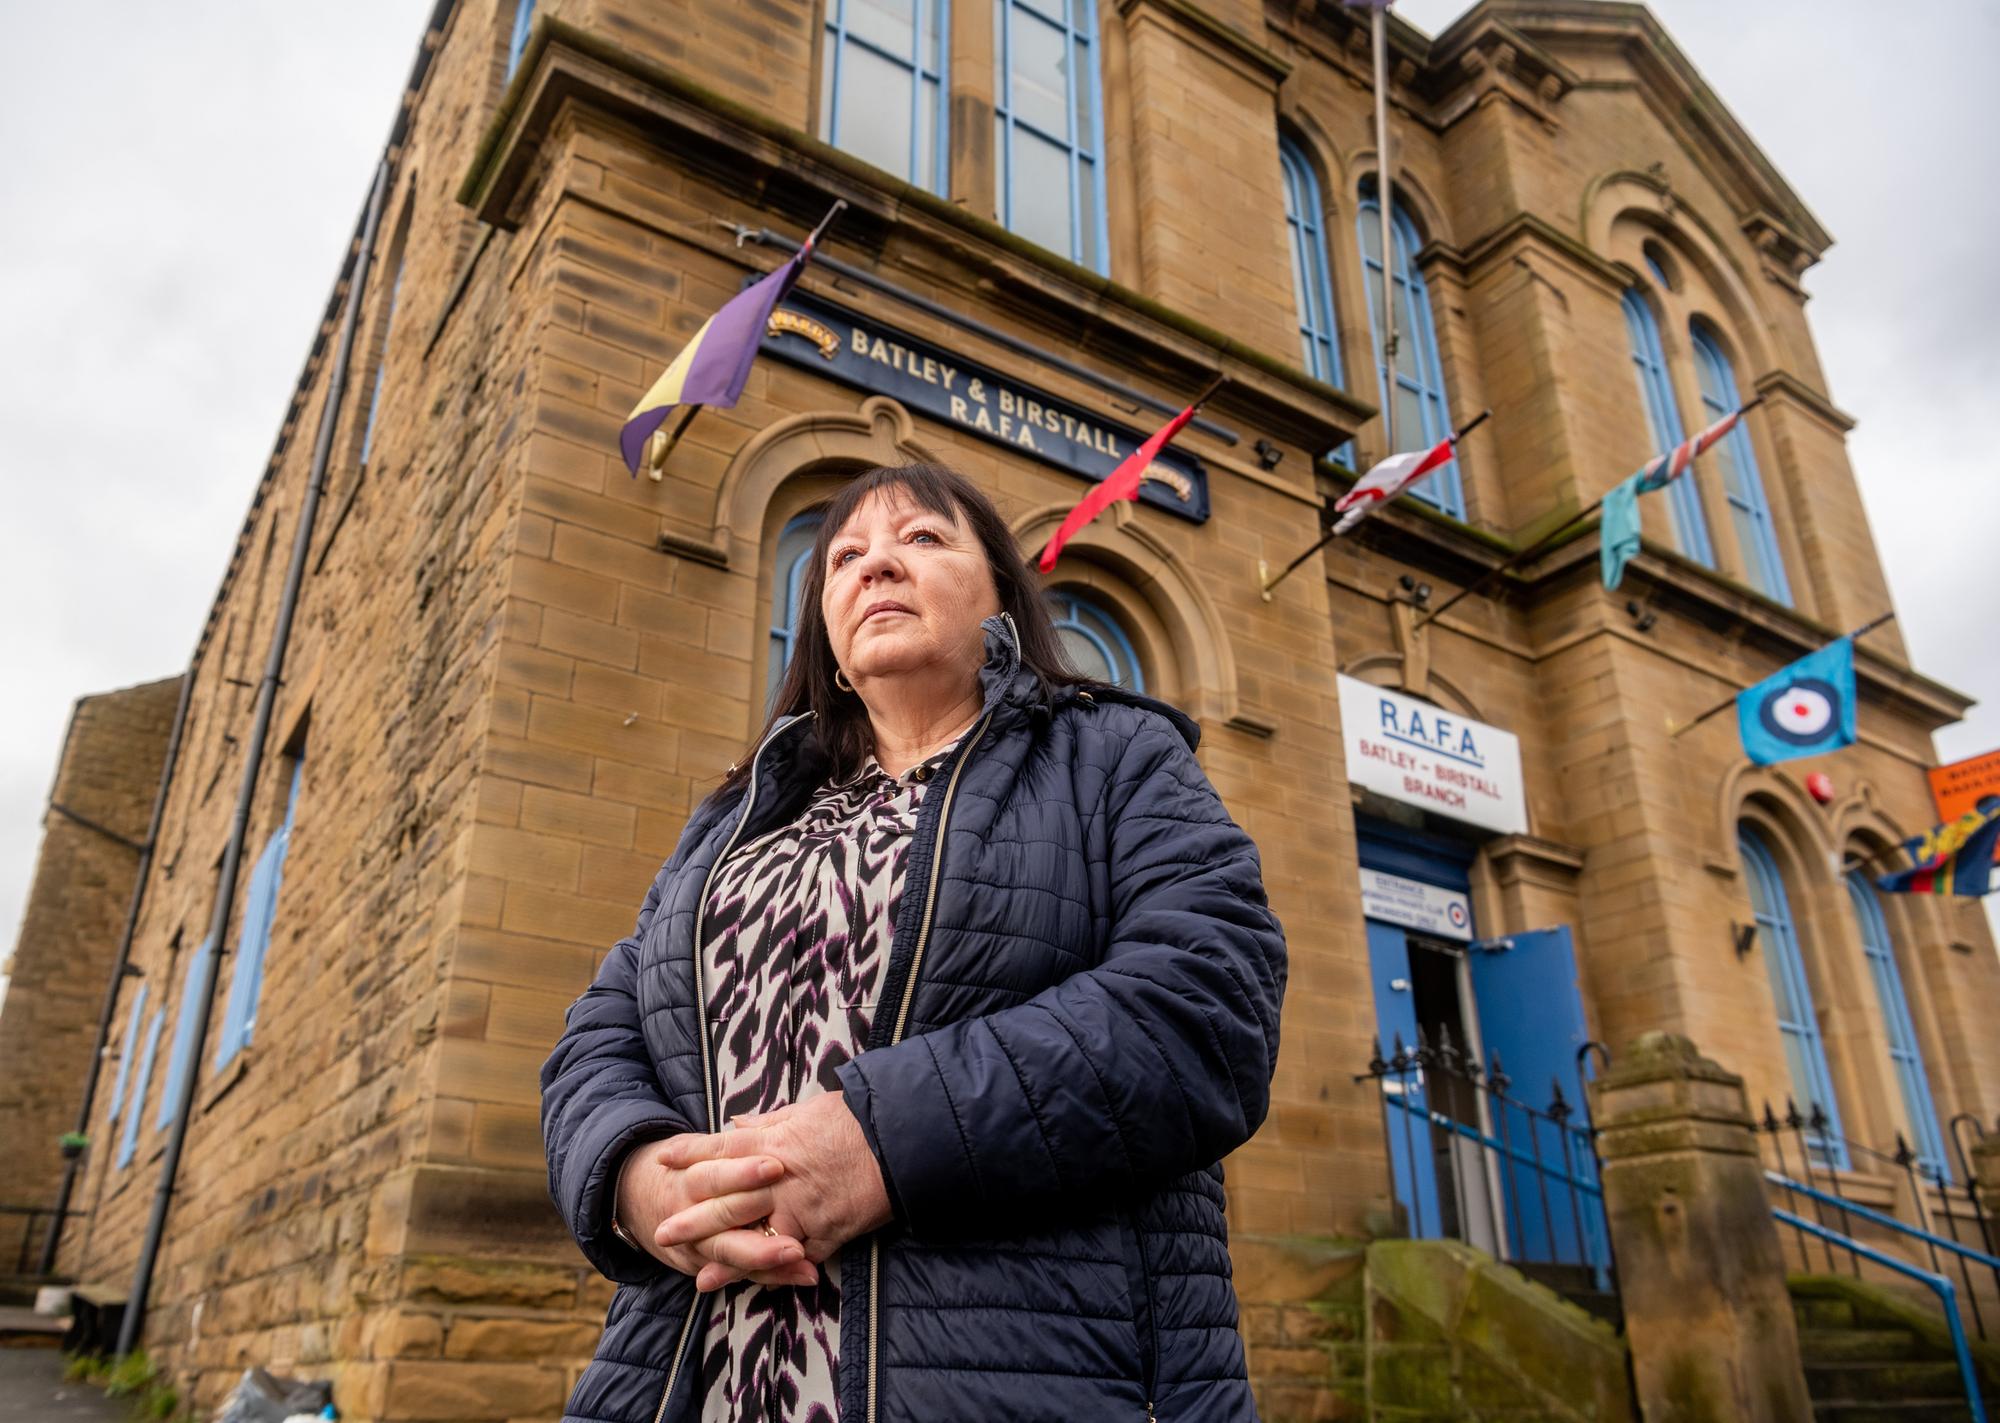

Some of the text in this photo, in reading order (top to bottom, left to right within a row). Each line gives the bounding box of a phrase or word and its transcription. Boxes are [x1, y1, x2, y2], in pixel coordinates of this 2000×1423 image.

[851, 327, 1122, 459] BATLEY & BIRSTALL
[950, 396, 1044, 453] R.A.F.A.
[1379, 698, 1486, 761] R.A.F.A.
[1359, 739, 1417, 771] BATLEY
[1434, 764, 1503, 800] BIRSTALL
[1402, 776, 1467, 810] BRANCH
